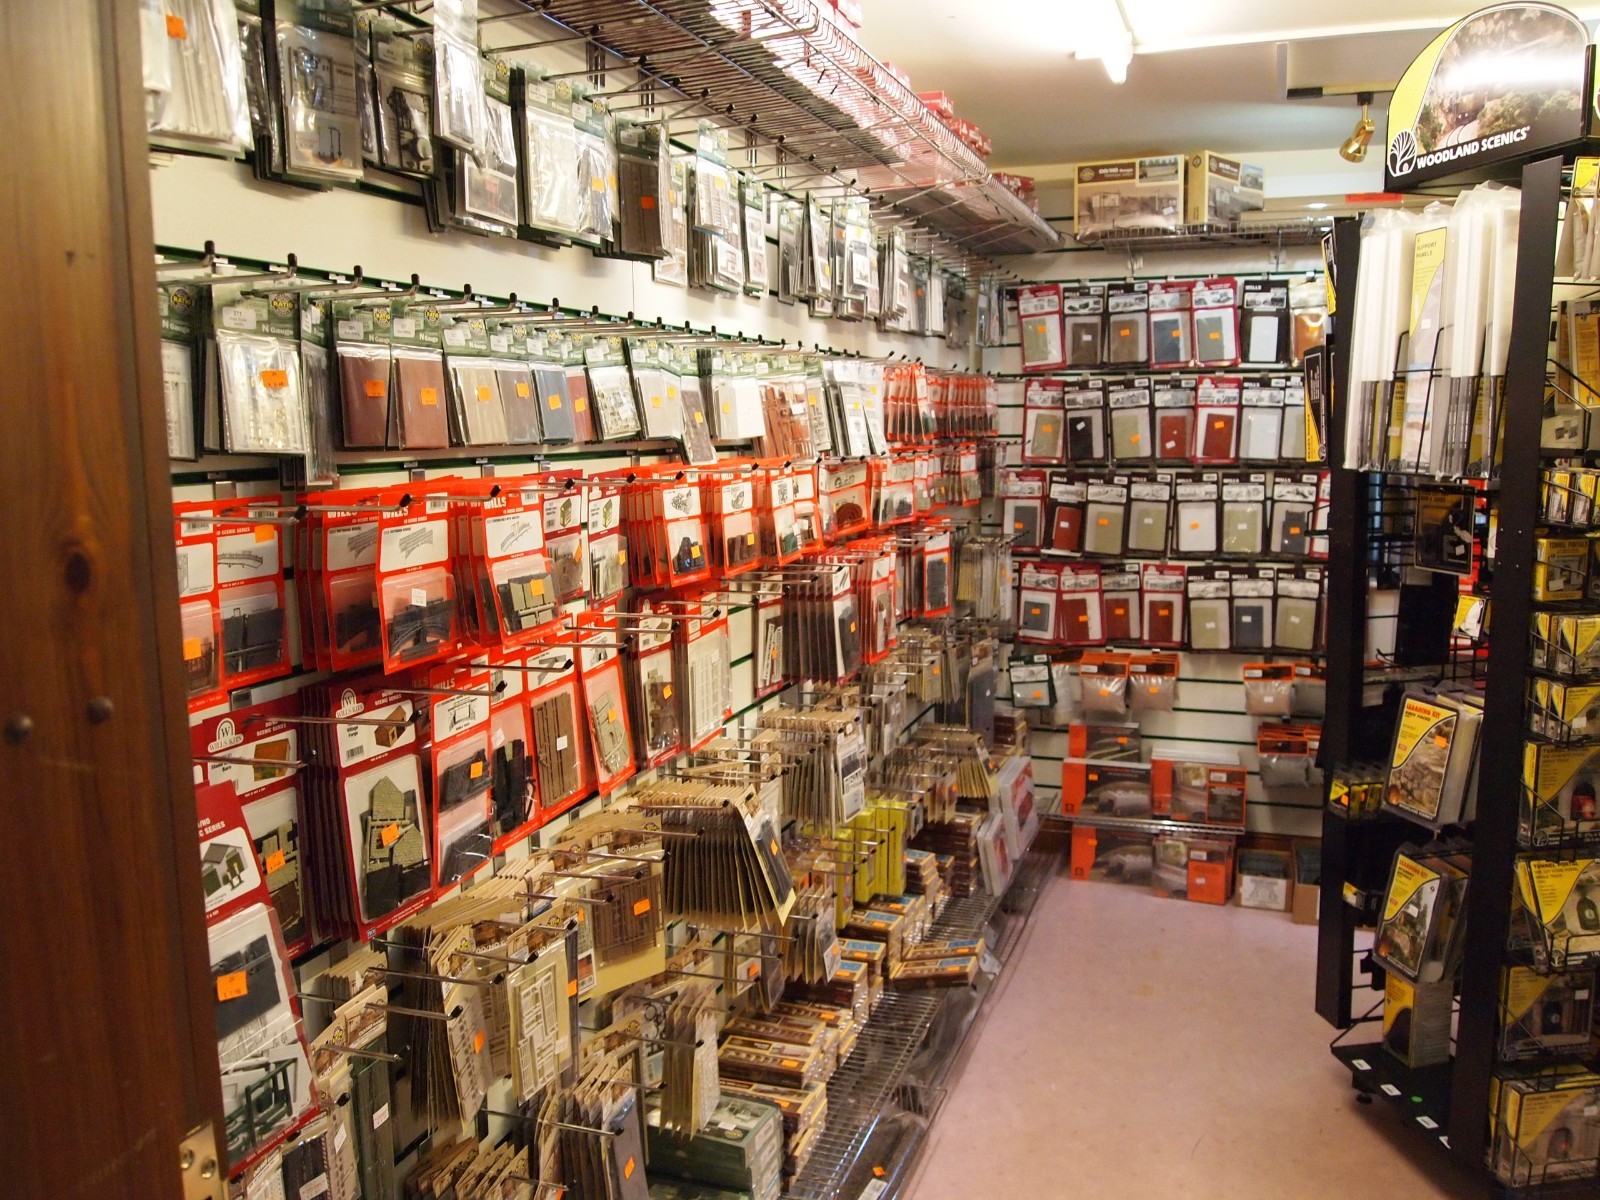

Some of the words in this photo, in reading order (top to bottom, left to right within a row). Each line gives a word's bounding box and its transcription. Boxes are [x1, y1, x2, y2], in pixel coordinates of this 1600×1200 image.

[1416, 141, 1482, 169] WOODLAND
[1481, 129, 1527, 152] SCENICS
[171, 295, 192, 305] RATIO
[272, 300, 294, 308] RATIO
[170, 323, 191, 334] Gauge
[262, 323, 269, 333] N
[270, 327, 294, 335] Gauge
[484, 497, 506, 510] WILLS
[345, 695, 356, 706] W
[375, 698, 388, 706] SCENIC
[221, 726, 231, 738] W
[257, 728, 272, 736] SCENIC
[272, 723, 286, 731] SERIES
[209, 739, 228, 751] WILLS
[229, 735, 242, 746] KITS
[204, 821, 226, 835] SERIES
